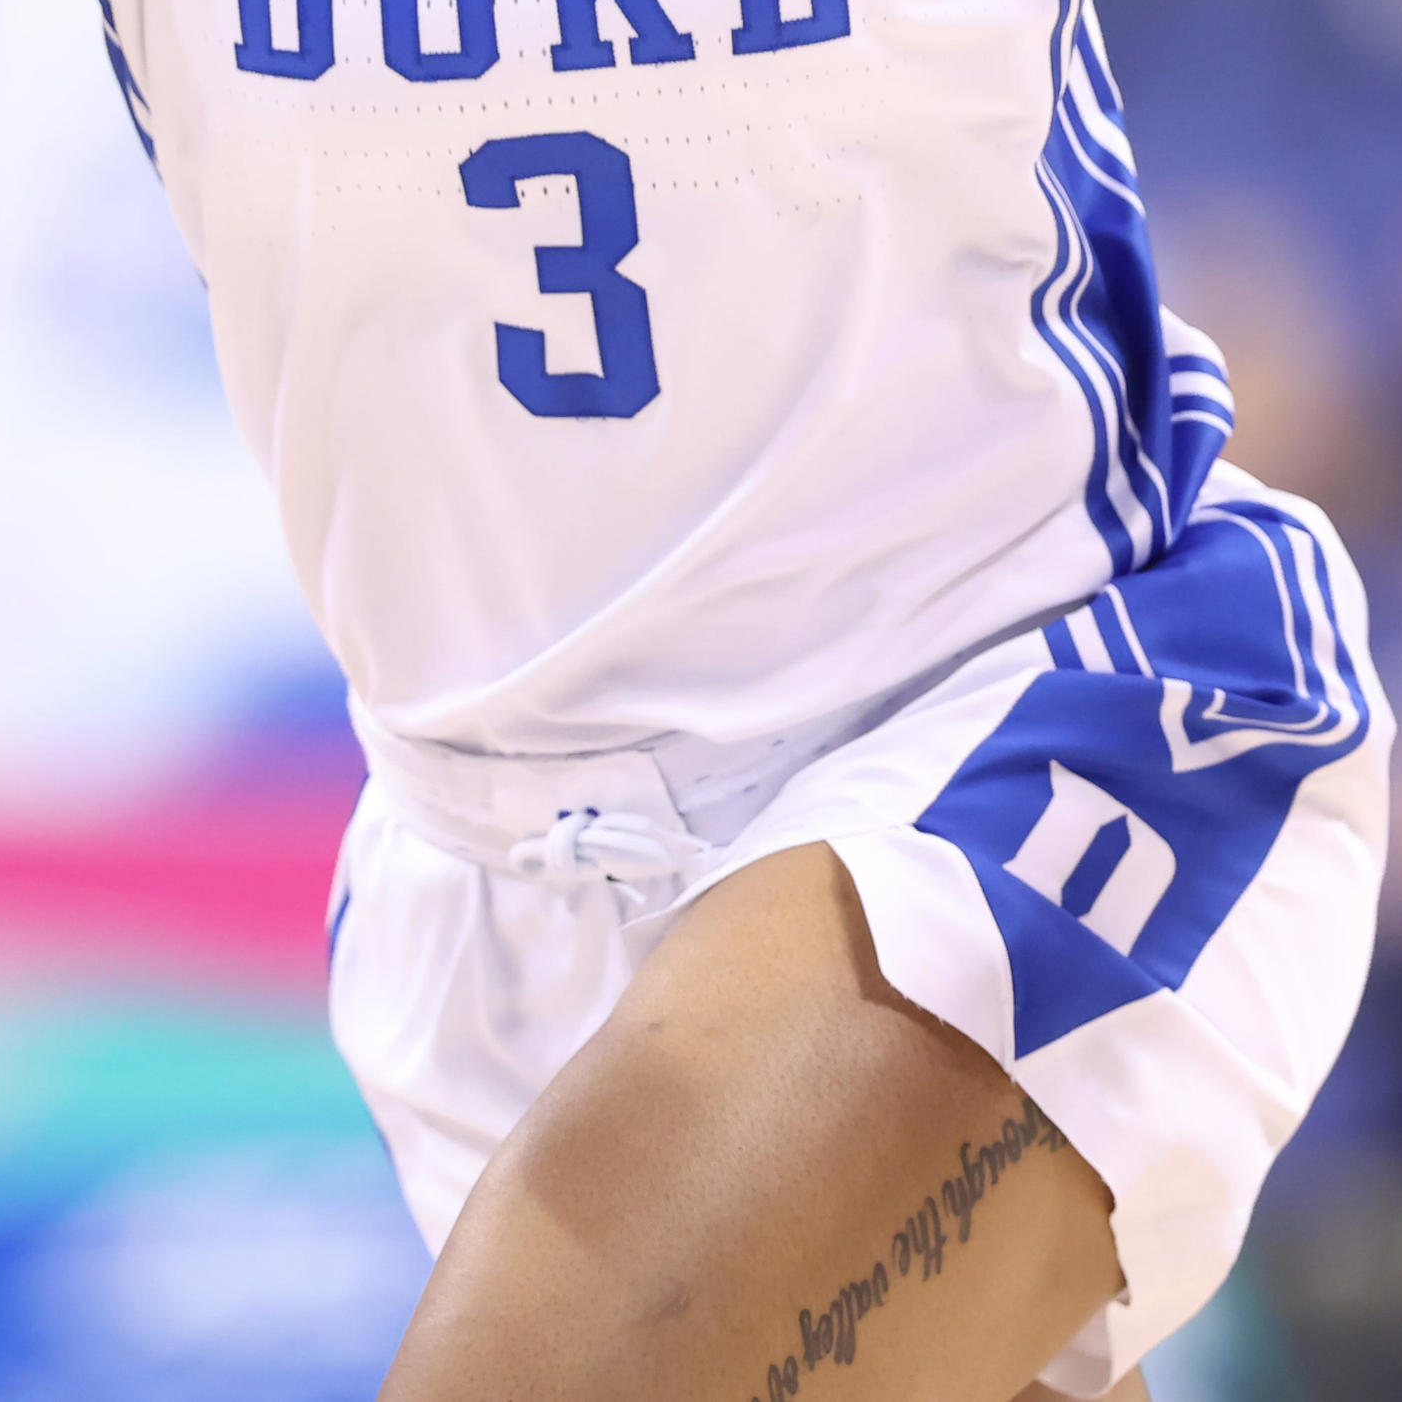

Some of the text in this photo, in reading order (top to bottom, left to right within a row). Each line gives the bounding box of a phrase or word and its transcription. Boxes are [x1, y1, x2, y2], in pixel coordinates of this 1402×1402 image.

[459, 131, 660, 418] 3
[1002, 760, 1176, 957] D
[891, 1195, 948, 1282] the
[799, 1260, 889, 1372] valley
